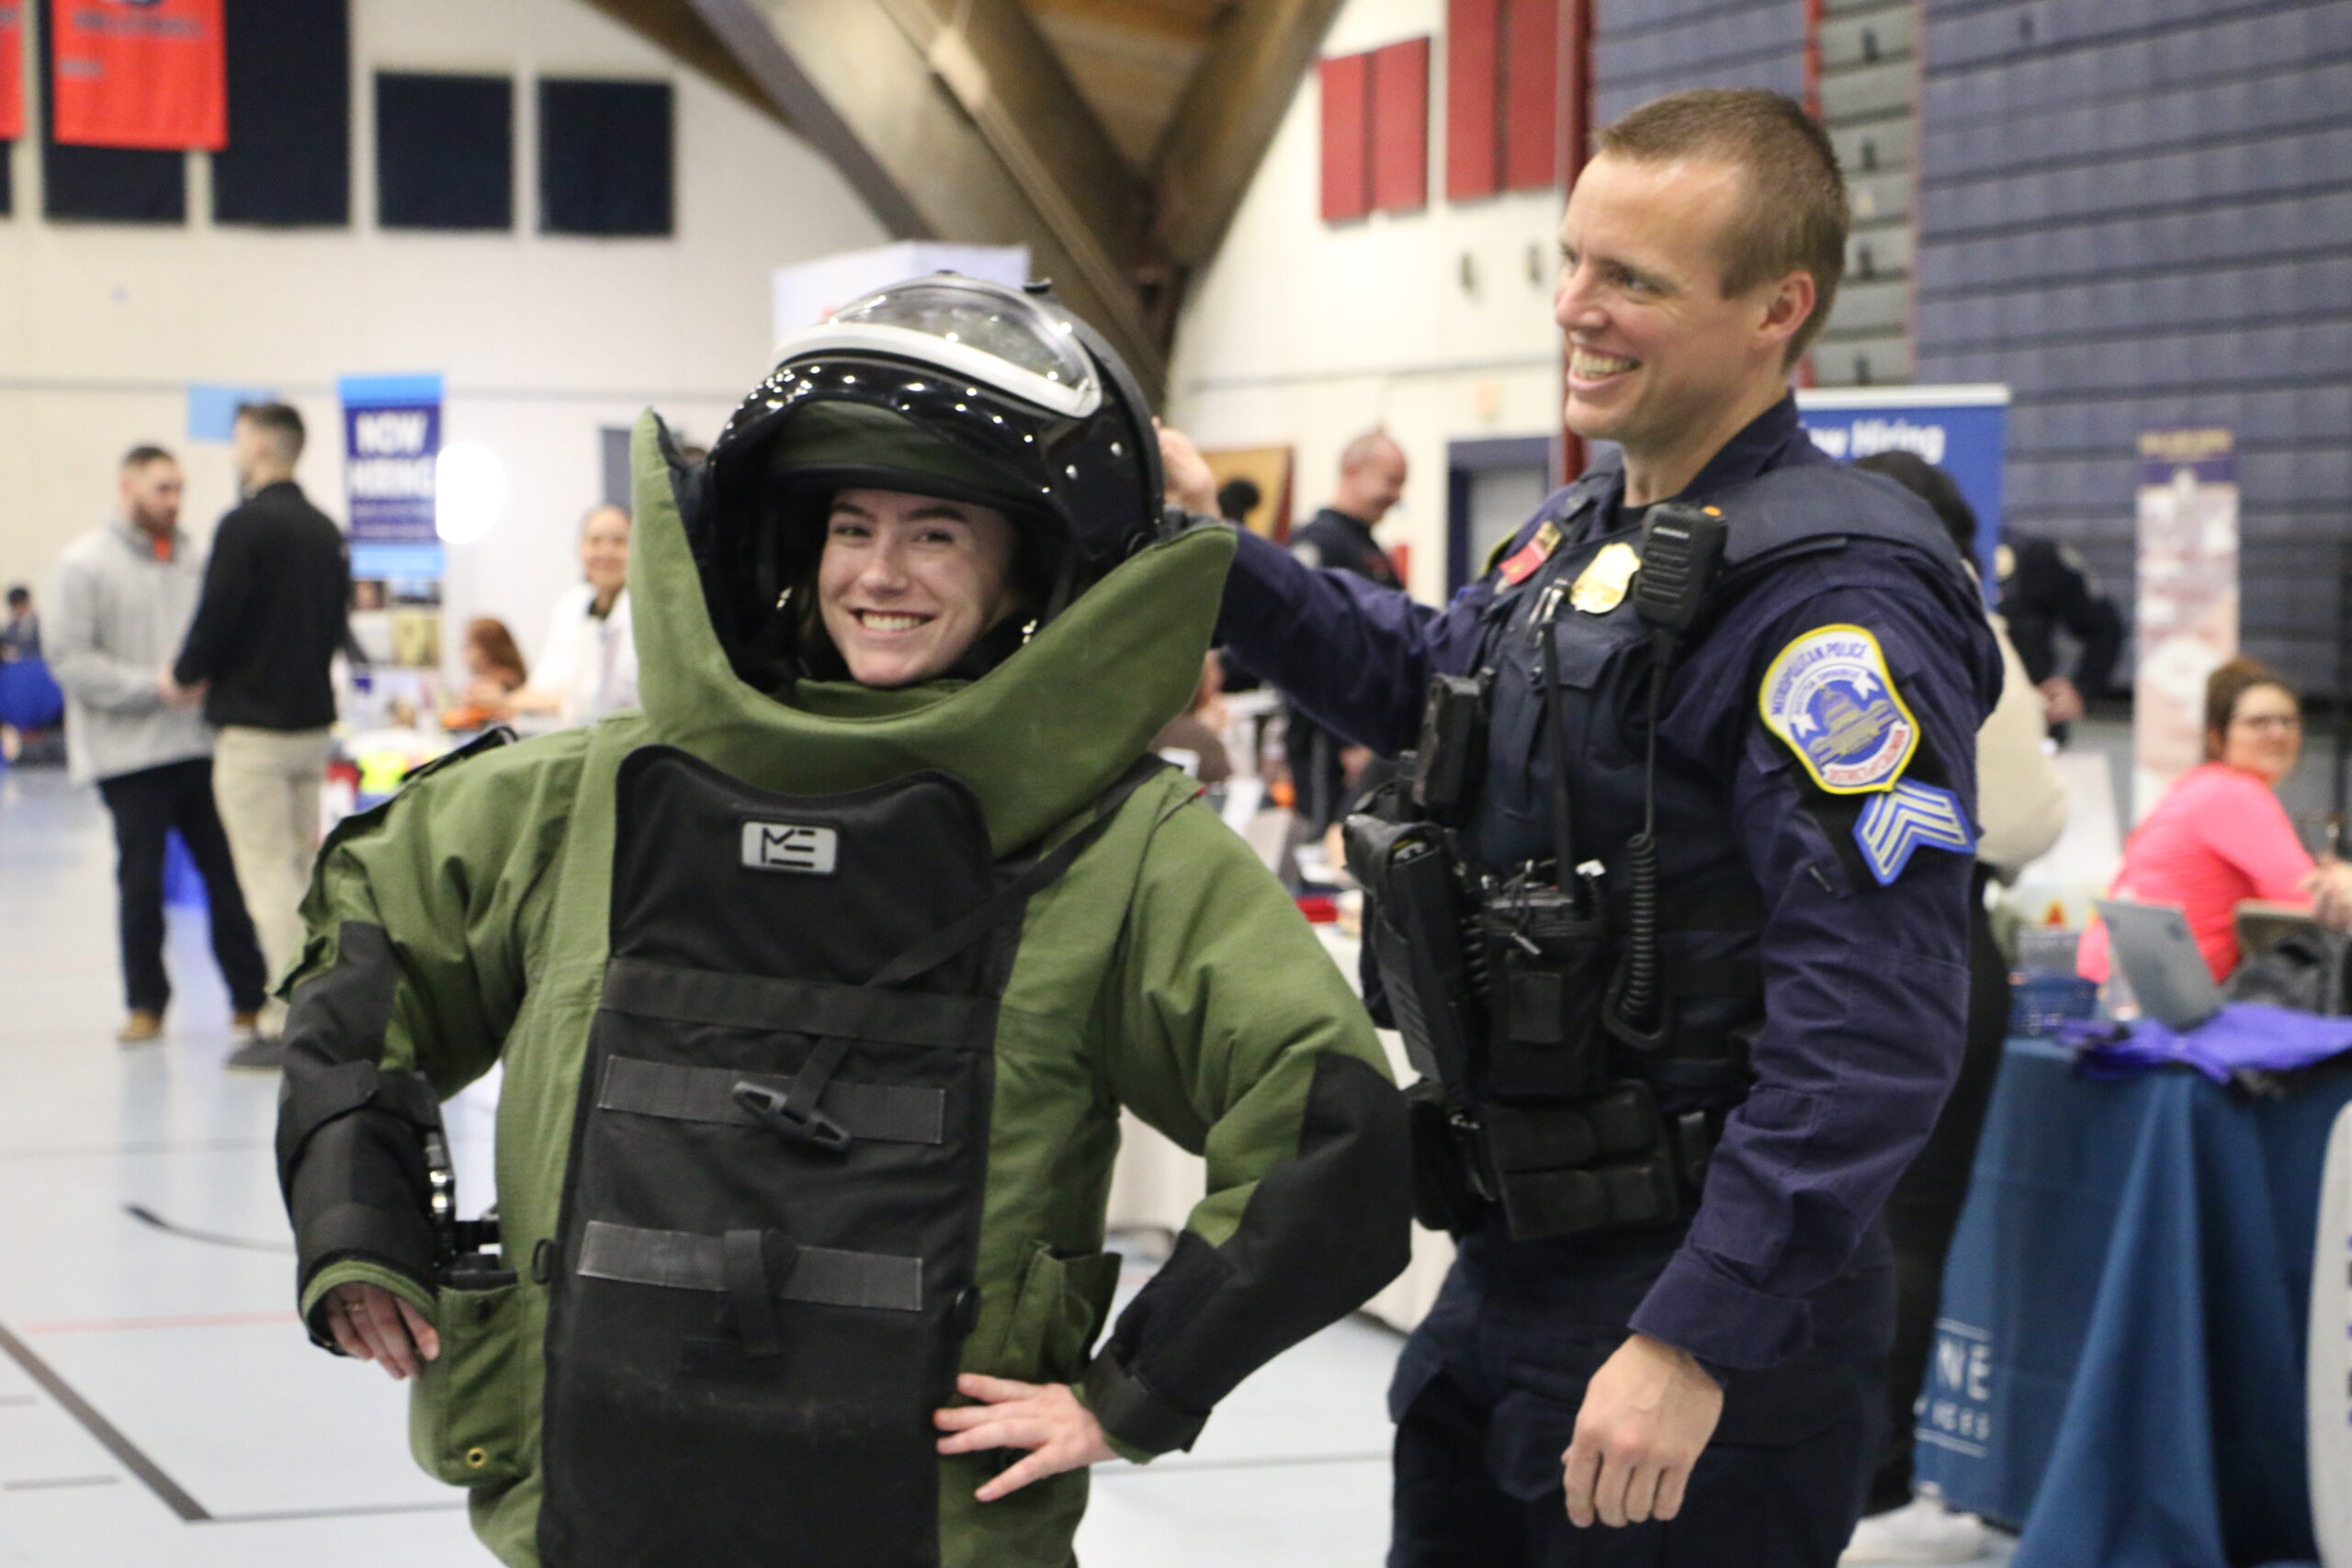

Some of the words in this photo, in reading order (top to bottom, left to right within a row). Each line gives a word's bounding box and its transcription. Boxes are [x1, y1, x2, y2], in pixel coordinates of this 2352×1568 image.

[356, 412, 427, 456] NOW
[1851, 418, 1945, 464] Hiring
[1826, 641, 1870, 660] POLICE
